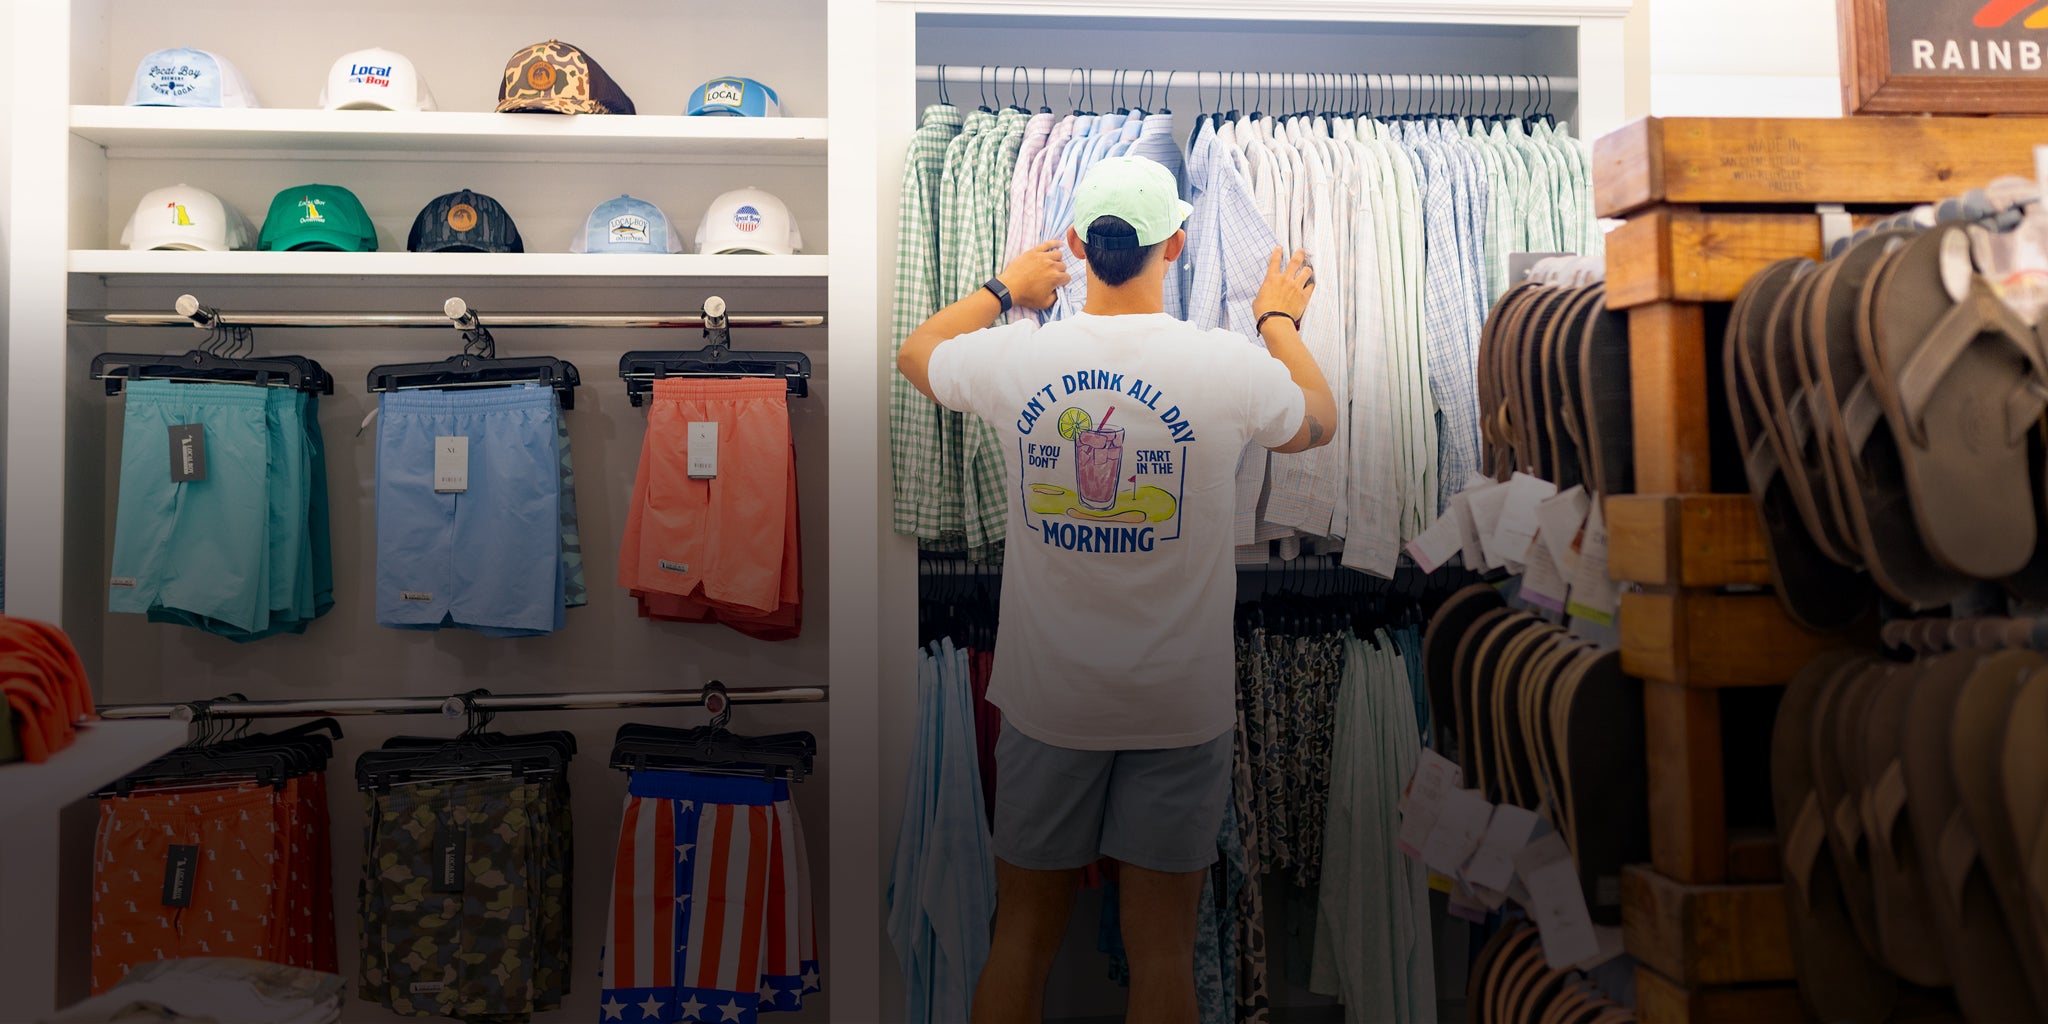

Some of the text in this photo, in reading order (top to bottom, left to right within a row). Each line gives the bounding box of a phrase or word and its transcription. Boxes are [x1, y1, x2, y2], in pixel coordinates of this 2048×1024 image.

[1911, 38, 2048, 70] RAINB
[178, 65, 201, 79] Boy
[350, 63, 392, 77] Local
[150, 82, 196, 96] DRINK LOCAL
[365, 76, 390, 88] Boy
[707, 90, 739, 102] LOCAL
[1016, 369, 1196, 444] CAN'T DRINK ALL DAY
[1027, 443, 1061, 458] IF YOU
[1136, 450, 1171, 462] START
[1136, 462, 1174, 475] IN THE
[1041, 519, 1155, 553] MORNING
